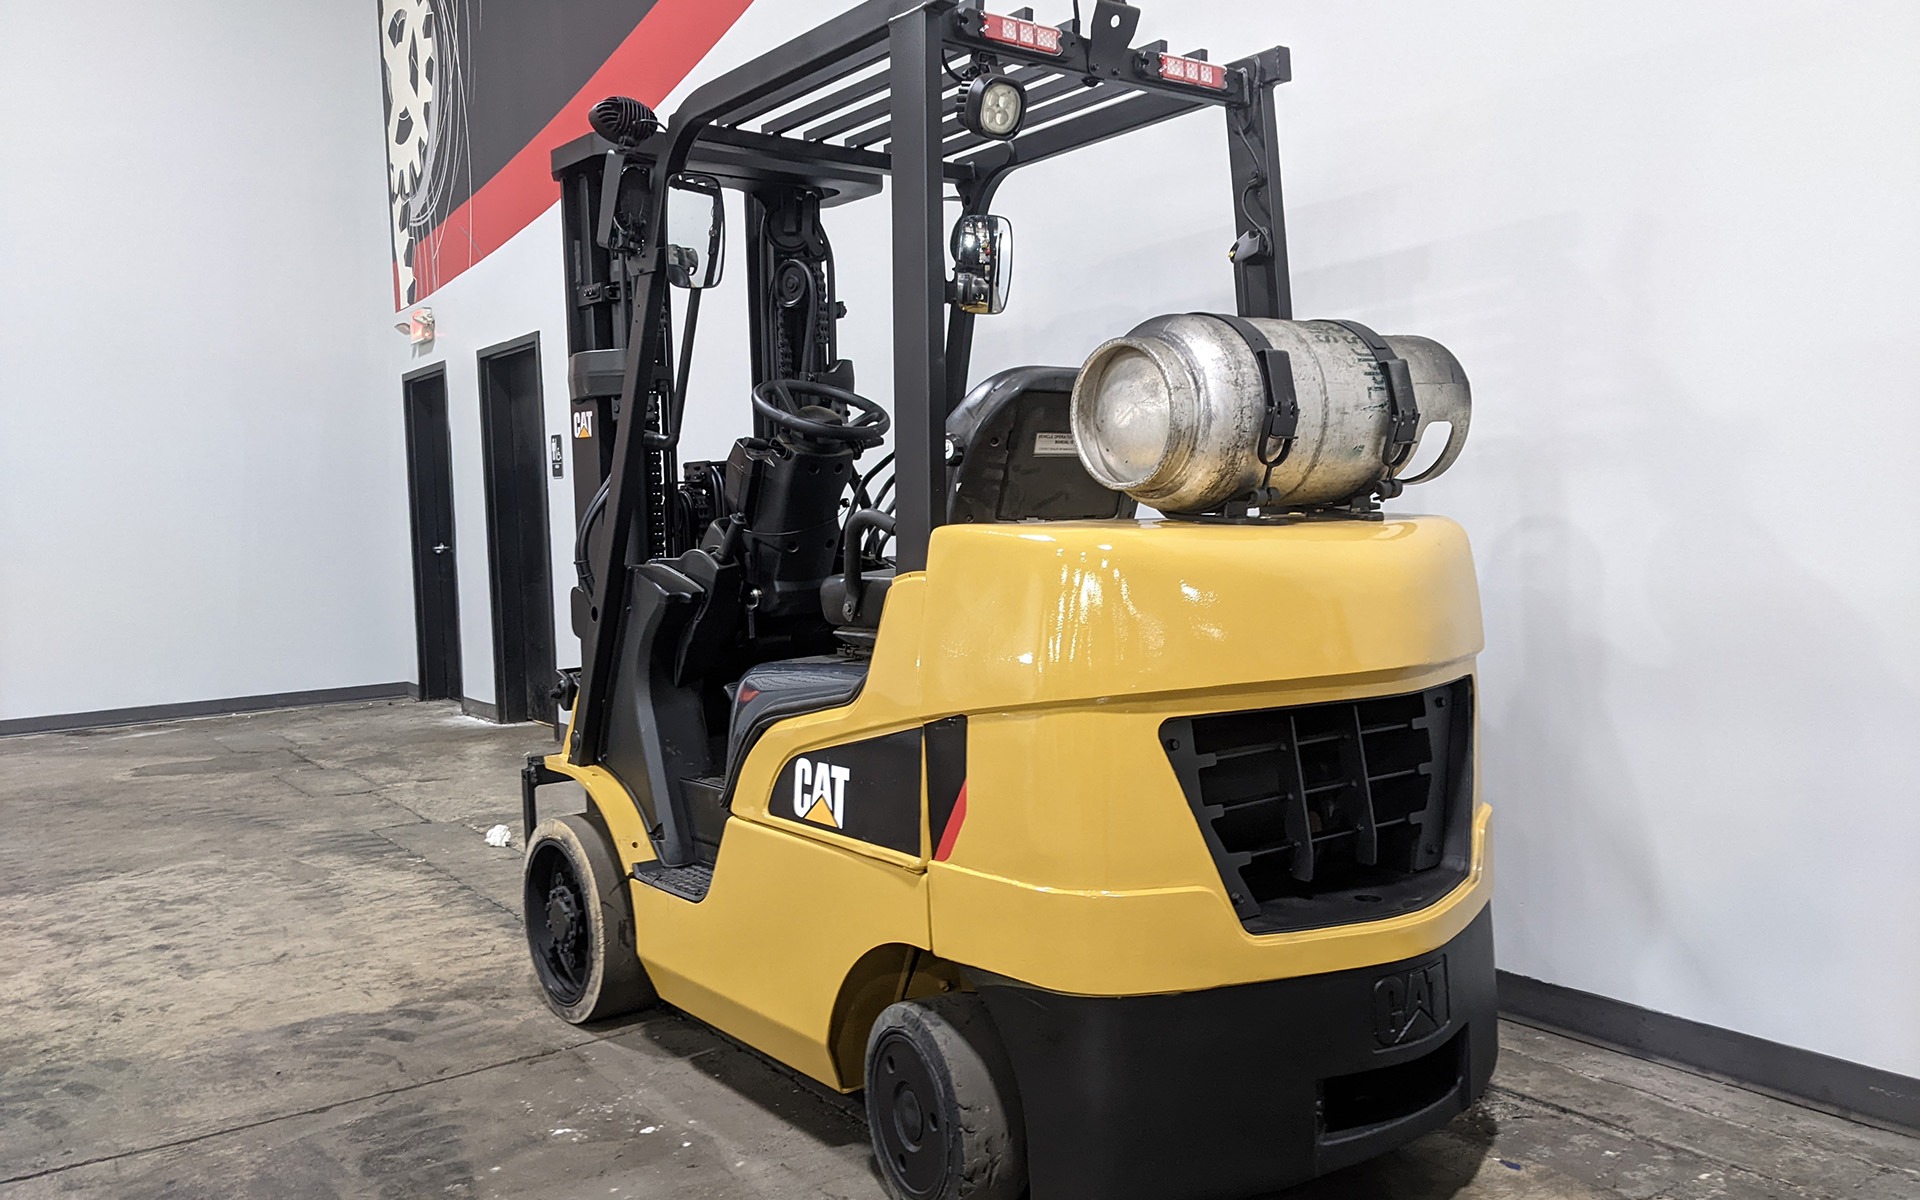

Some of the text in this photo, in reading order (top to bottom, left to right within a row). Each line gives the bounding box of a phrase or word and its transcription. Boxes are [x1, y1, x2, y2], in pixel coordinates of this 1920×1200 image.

[573, 410, 593, 439] CAT
[793, 757, 850, 830] CAT
[1373, 957, 1450, 1047] CAT
